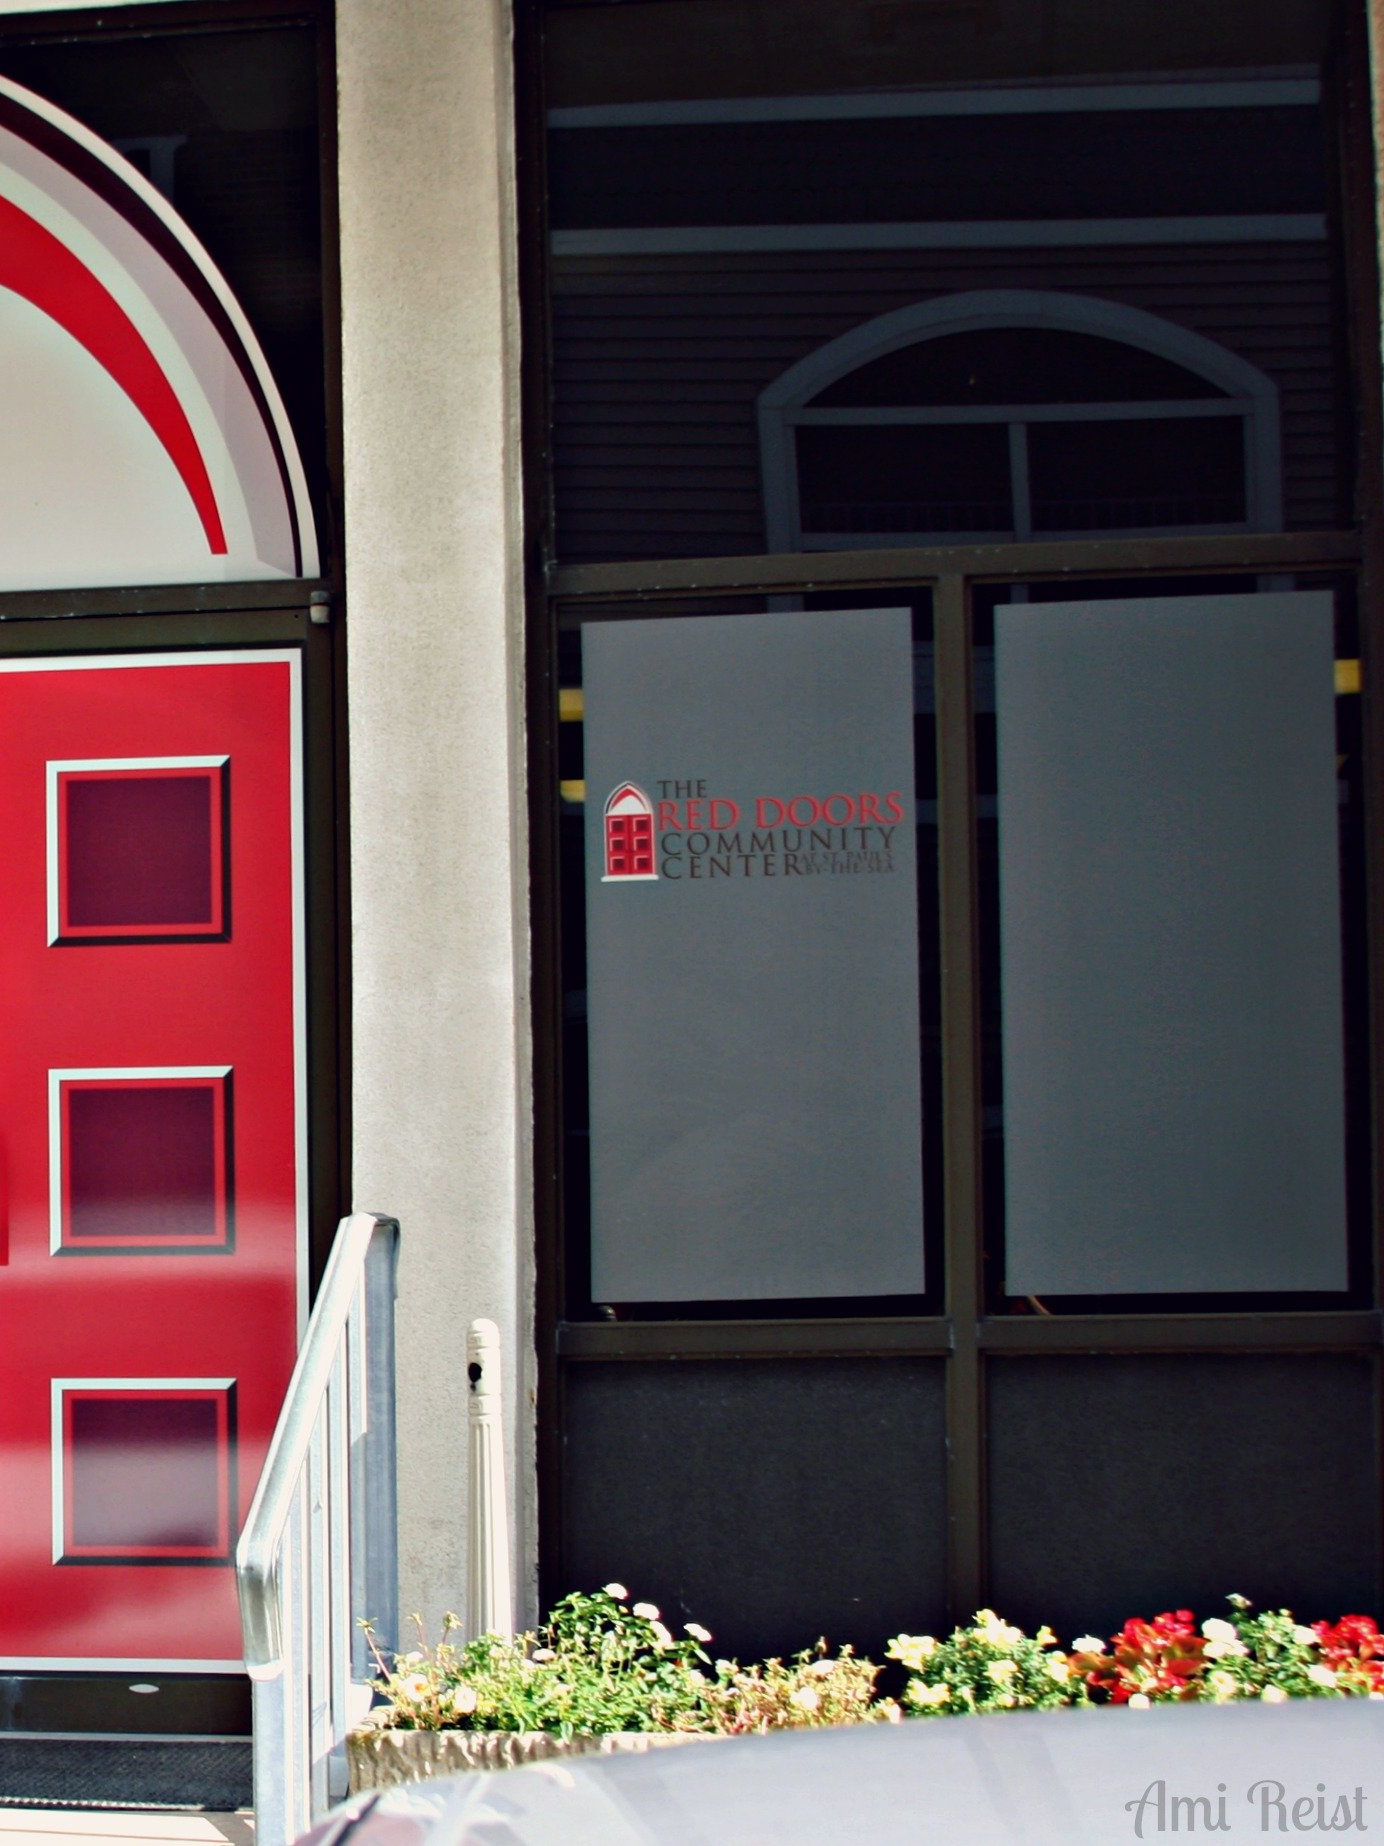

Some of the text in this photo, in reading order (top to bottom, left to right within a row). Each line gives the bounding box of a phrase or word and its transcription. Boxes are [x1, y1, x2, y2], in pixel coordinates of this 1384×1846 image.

[657, 779, 708, 799] THE
[658, 791, 905, 831] RED DOORS
[662, 826, 896, 856] COMMUNITY
[662, 853, 806, 880] CENTER
